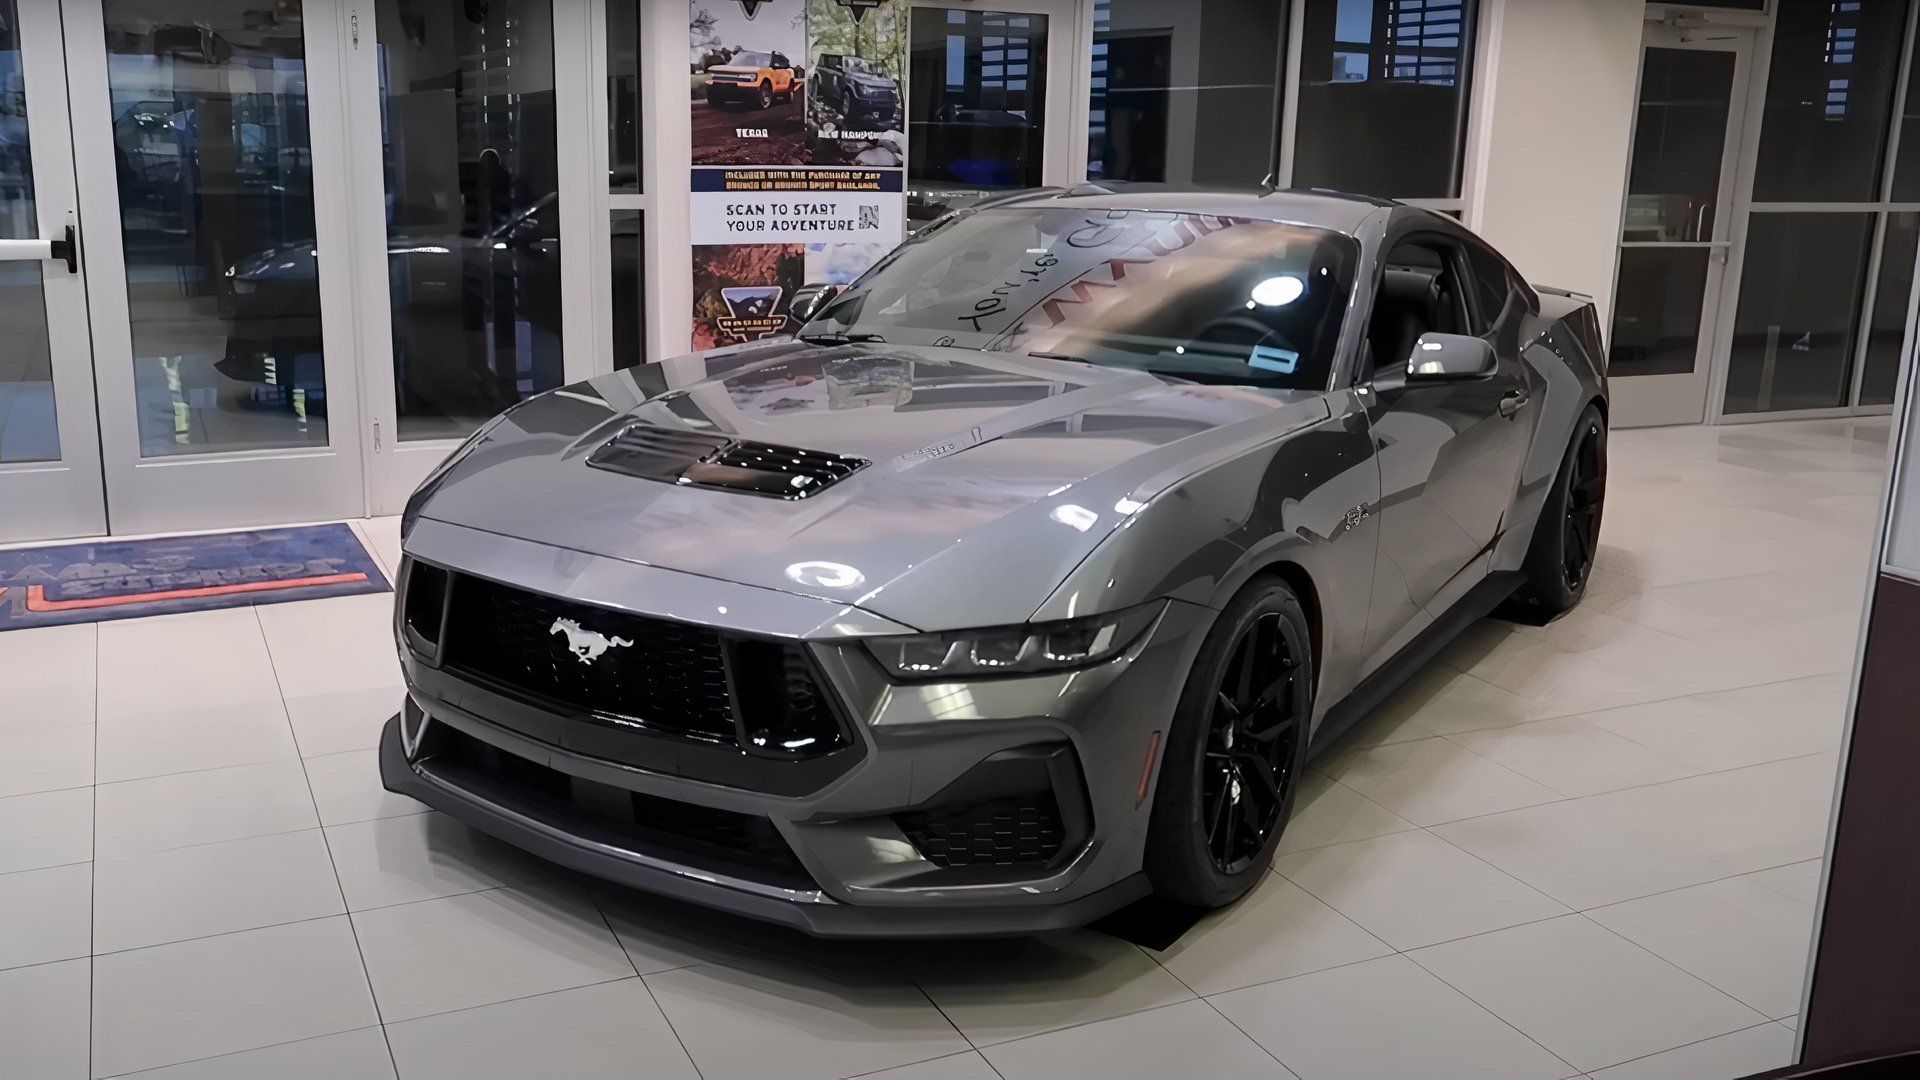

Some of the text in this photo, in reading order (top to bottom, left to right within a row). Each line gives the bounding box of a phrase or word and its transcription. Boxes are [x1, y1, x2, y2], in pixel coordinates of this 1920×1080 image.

[726, 203, 837, 216] SCAN TO START
[726, 219, 855, 232] YOUR ADVENTURE
